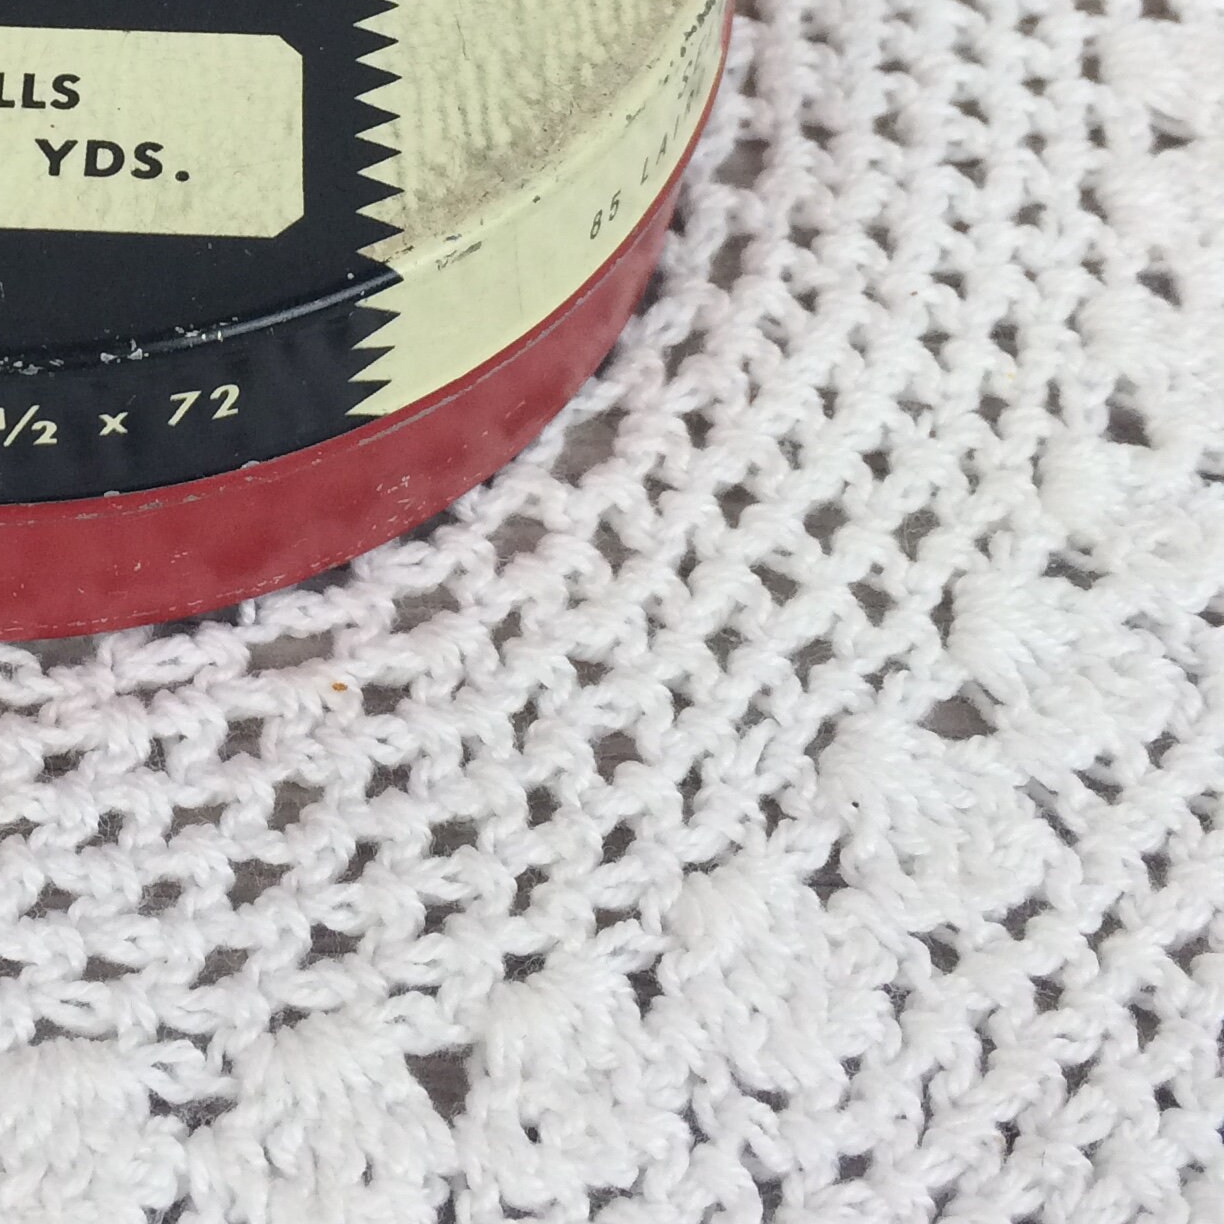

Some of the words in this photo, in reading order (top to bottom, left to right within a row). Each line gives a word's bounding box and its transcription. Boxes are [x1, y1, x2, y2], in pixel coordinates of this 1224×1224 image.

[34, 138, 190, 183] YDS.
[589, 189, 622, 240] 85
[167, 384, 240, 426] 72
